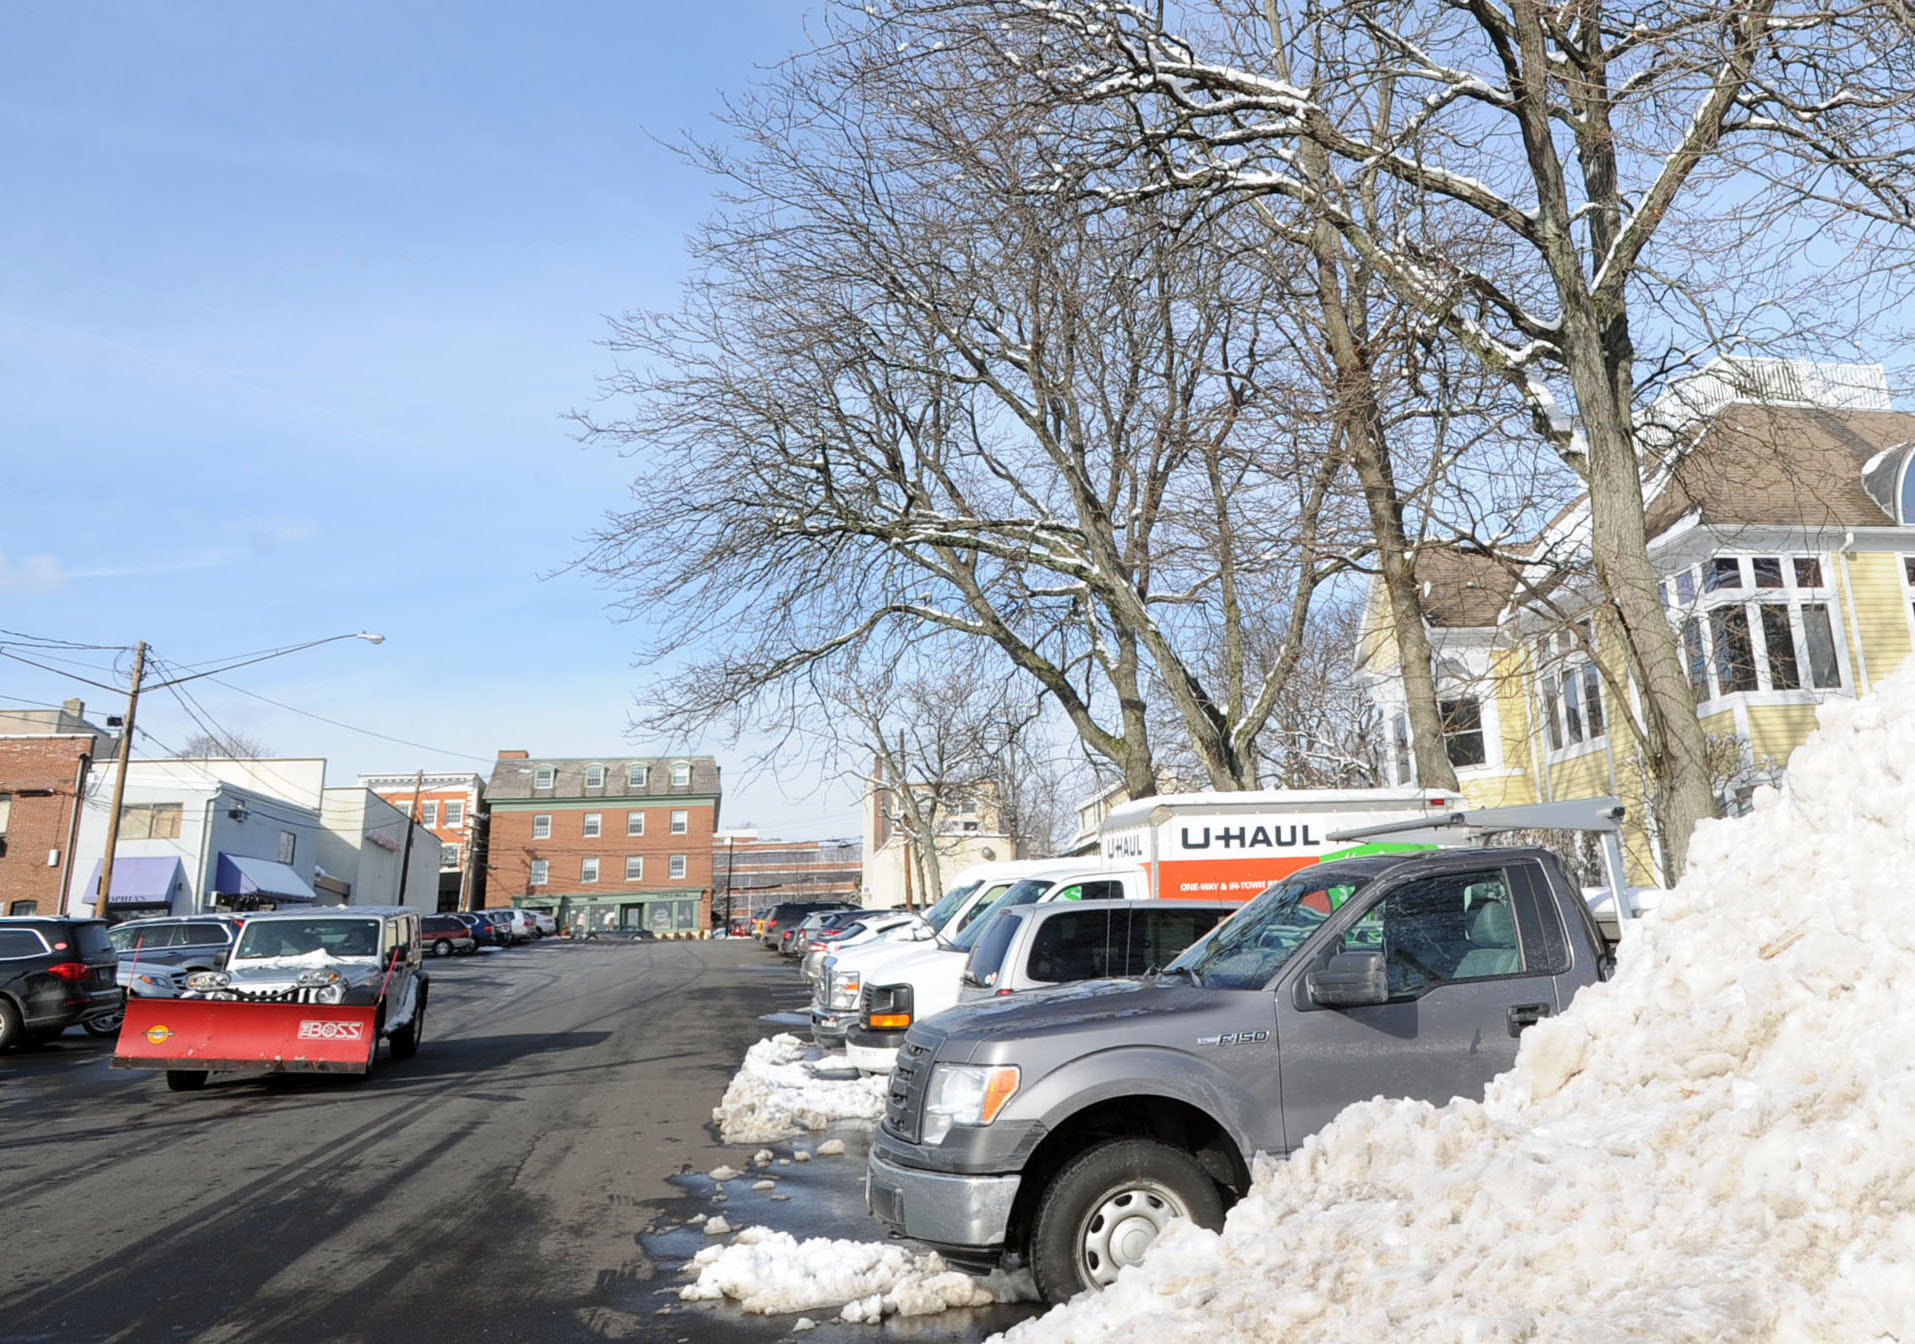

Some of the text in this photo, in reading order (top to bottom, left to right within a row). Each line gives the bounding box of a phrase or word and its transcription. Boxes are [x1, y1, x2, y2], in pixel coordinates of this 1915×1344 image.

[1107, 834, 1143, 859] U-HAUL
[1181, 825, 1320, 849] U-HAUL
[1180, 882, 1218, 891] ONE-WAY
[1220, 881, 1227, 890] &
[1229, 880, 1265, 890] IN-TOWN
[309, 1022, 361, 1038] BOSS
